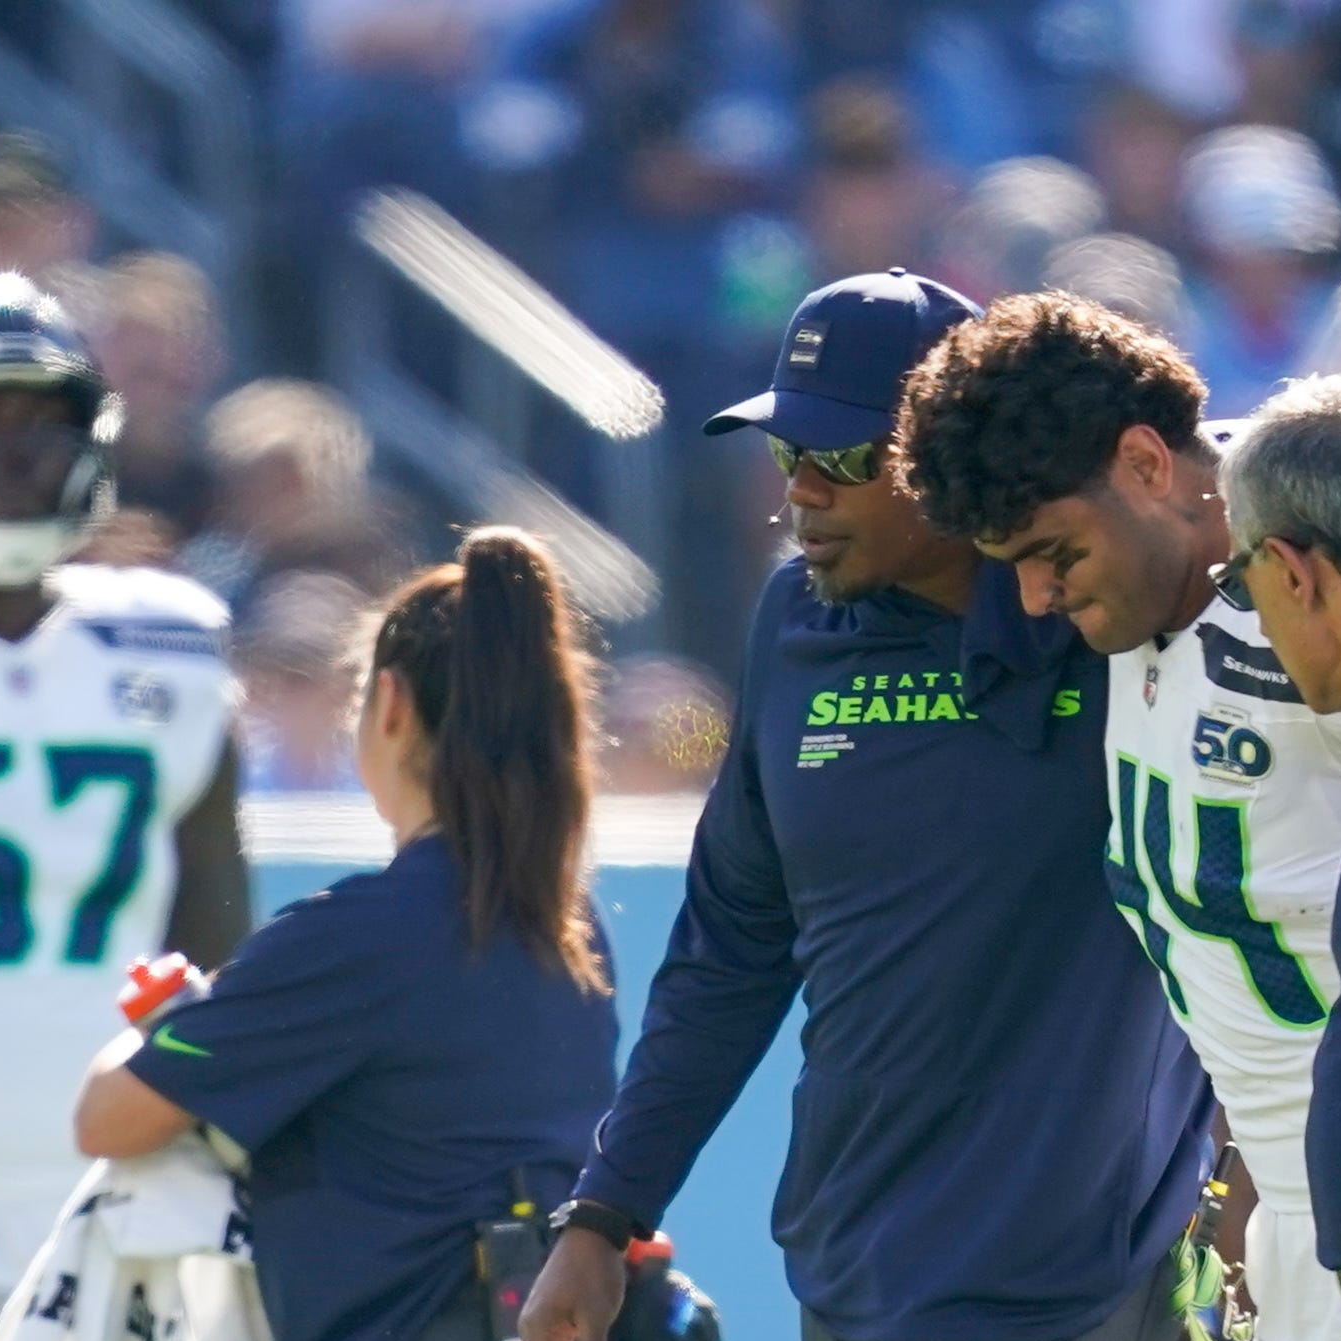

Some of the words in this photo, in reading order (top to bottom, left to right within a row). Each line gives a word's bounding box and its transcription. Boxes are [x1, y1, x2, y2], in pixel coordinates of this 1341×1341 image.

[852, 672, 963, 691] SEATT
[807, 689, 1082, 727] SEAHAS
[1191, 713, 1272, 778] 50
